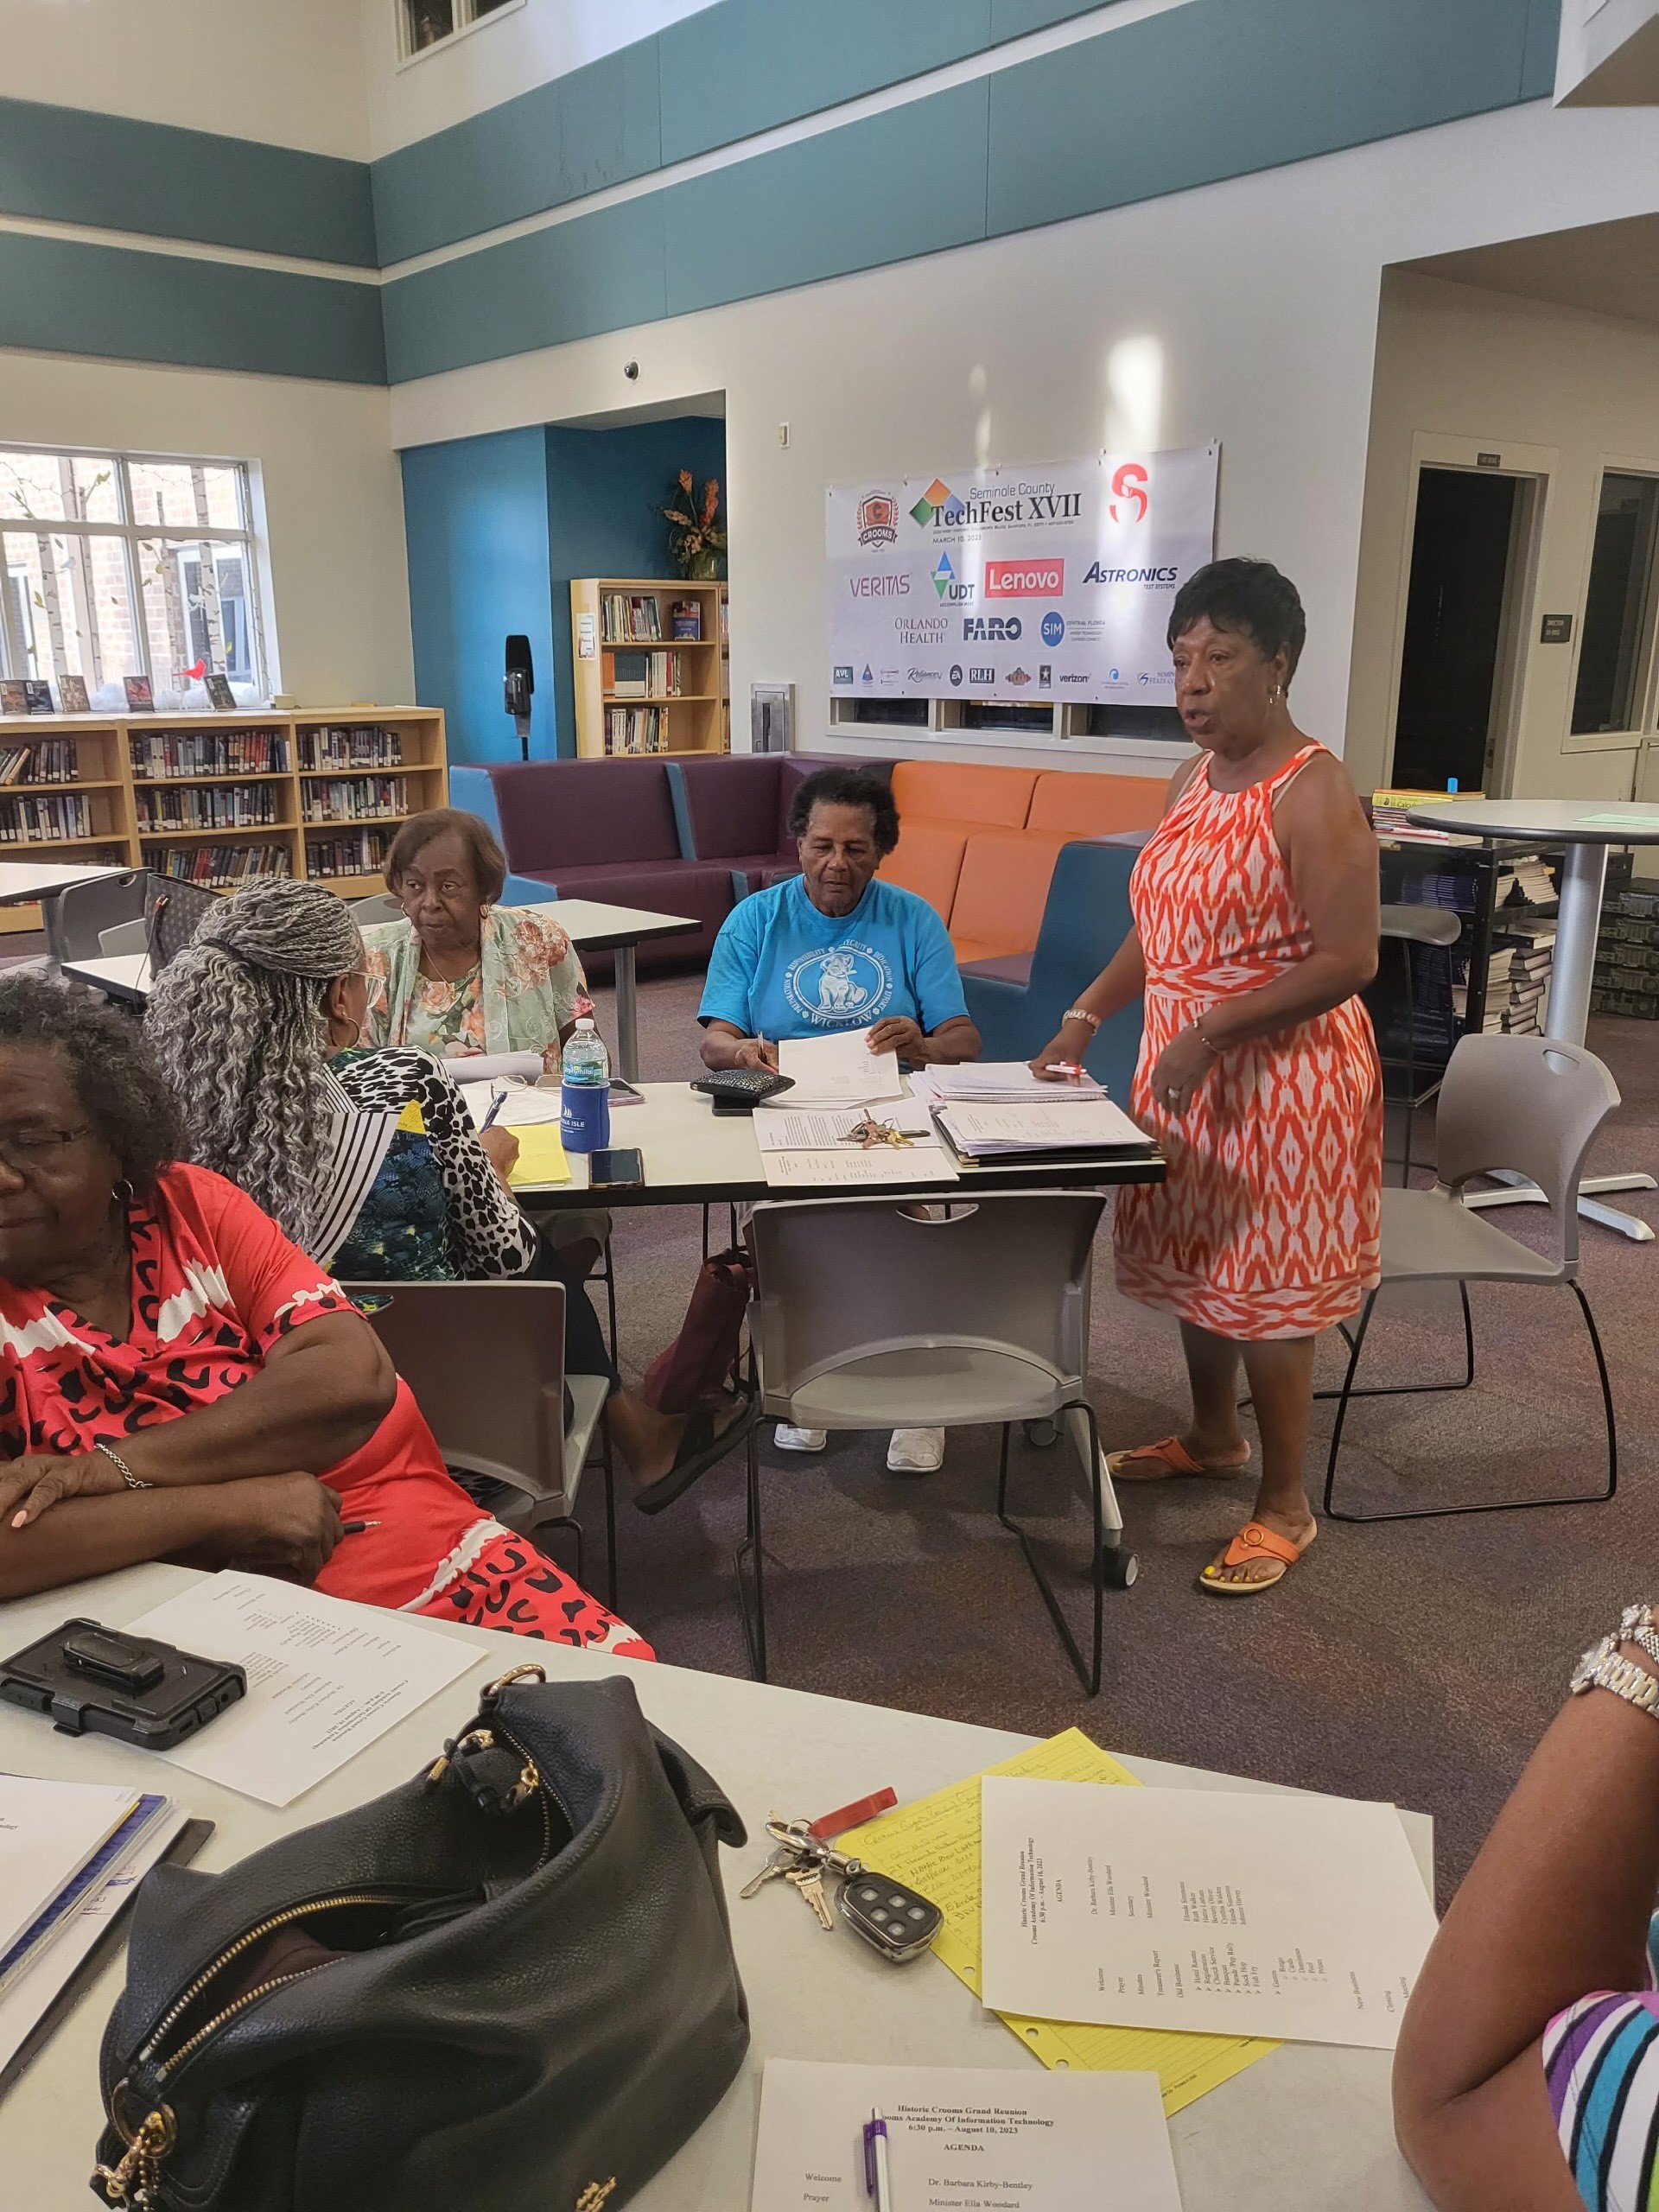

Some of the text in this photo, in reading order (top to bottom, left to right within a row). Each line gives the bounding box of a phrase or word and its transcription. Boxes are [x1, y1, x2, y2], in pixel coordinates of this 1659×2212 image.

[969, 482, 1055, 500] Seminole County
[931, 493, 1082, 527] TechFest XVII
[862, 528, 893, 541] CROOMS
[932, 536, 956, 544] MARCH
[989, 569, 1059, 591] Lenovo
[1083, 562, 1178, 584] ASTRONICS
[850, 574, 910, 597] VERITAS
[949, 584, 975, 600] UDT
[895, 617, 948, 630] ORLANDO
[963, 617, 1022, 641] FARO
[1044, 623, 1062, 635] SIM
[900, 632, 944, 644] HEALTH
[836, 670, 849, 678] AVL
[970, 670, 992, 681] RLH
[1059, 674, 1087, 683] verizon
[873, 951, 893, 983] DEDICATION
[783, 979, 804, 1014] PREPARATION
[880, 989, 893, 1011] EFFORT
[810, 1011, 873, 1029] WICKLOW
[1295, 1948, 1305, 1973] Dominoes
[1201, 1955, 1211, 1984] Registration
[1350, 1972, 1360, 1994] Business
[1385, 1991, 1394, 2012] Closing
[957, 2116, 1006, 2125] Information
[1008, 2118, 1054, 2126] Technology
[955, 2126, 983, 2134] August
[944, 2144, 985, 2152] AGENDA
[805, 2173, 842, 2183] Welcome
[928, 2178, 1033, 2190] Dr. Barbara Kirby-Bentley
[804, 2193, 830, 2202] Prayer
[929, 2199, 1020, 2209] Minister Ella Woodard
